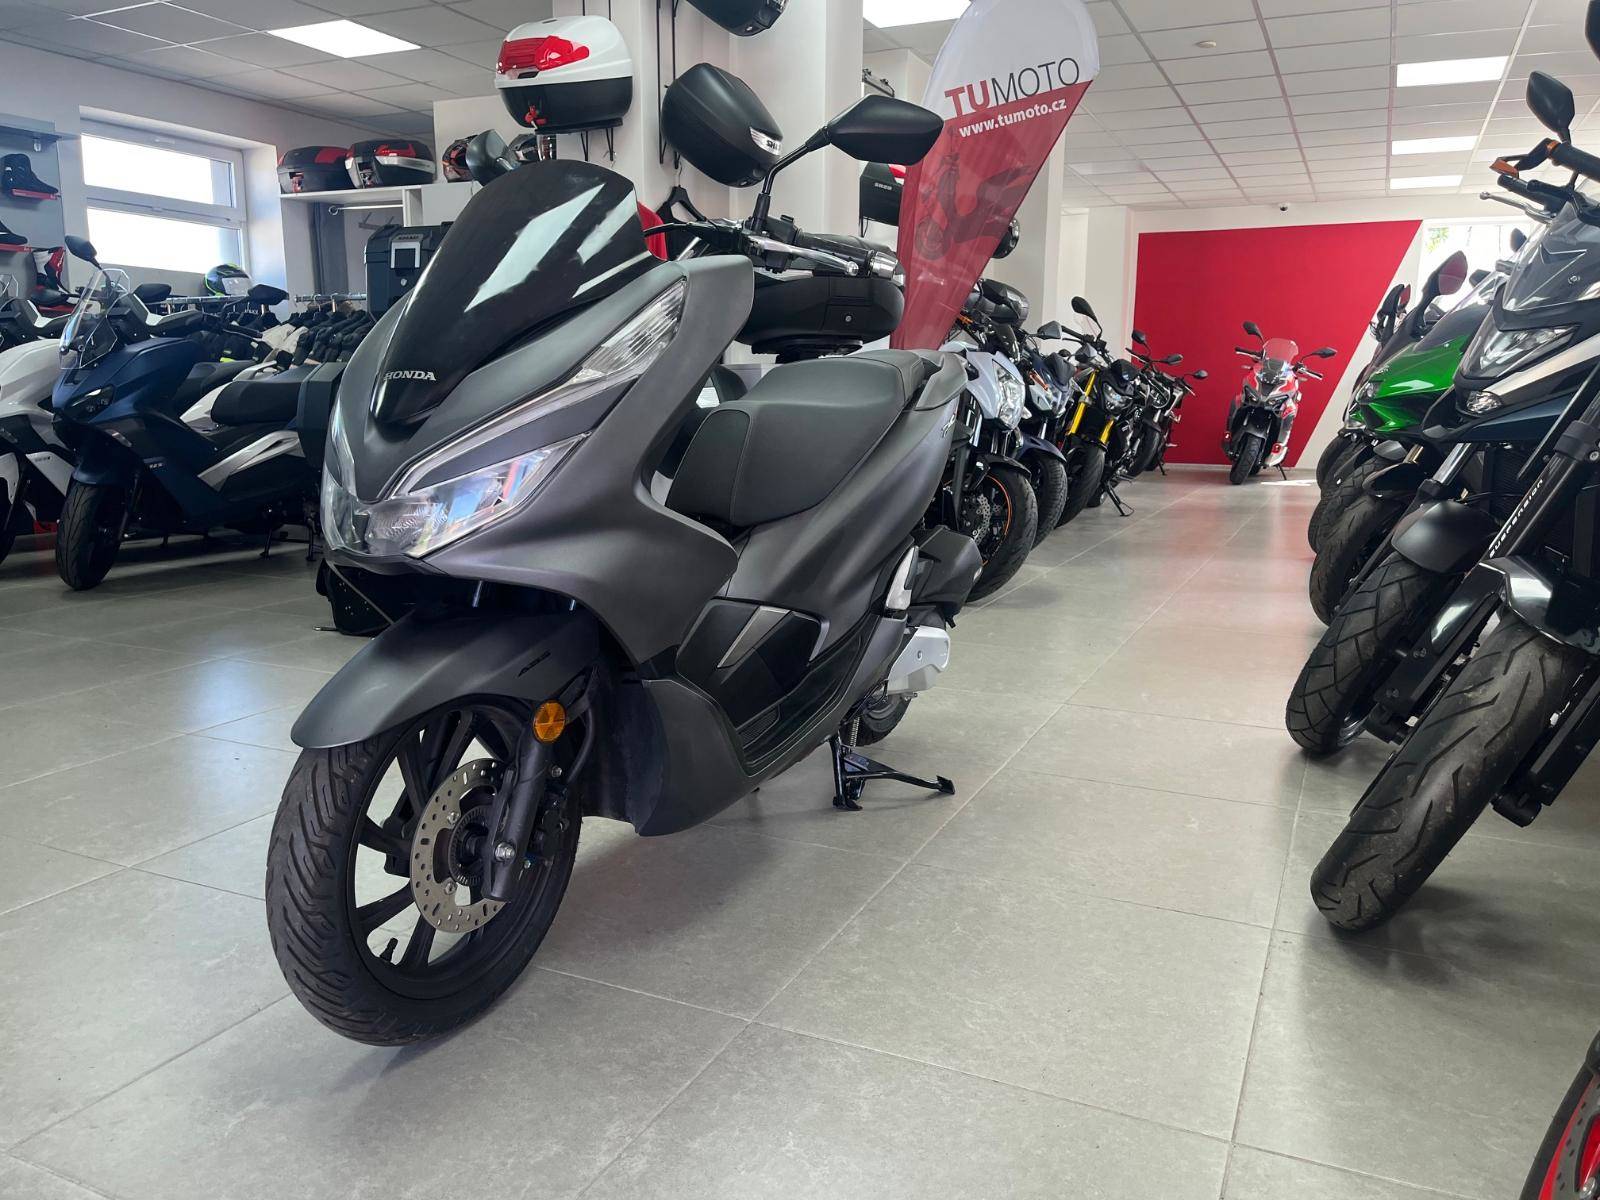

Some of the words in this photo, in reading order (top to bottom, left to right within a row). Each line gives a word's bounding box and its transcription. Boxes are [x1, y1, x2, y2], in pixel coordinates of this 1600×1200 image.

[944, 57, 1080, 118] TUMOTO
[958, 98, 1068, 138] www.tumoto.cz
[384, 370, 437, 381] HONDA
